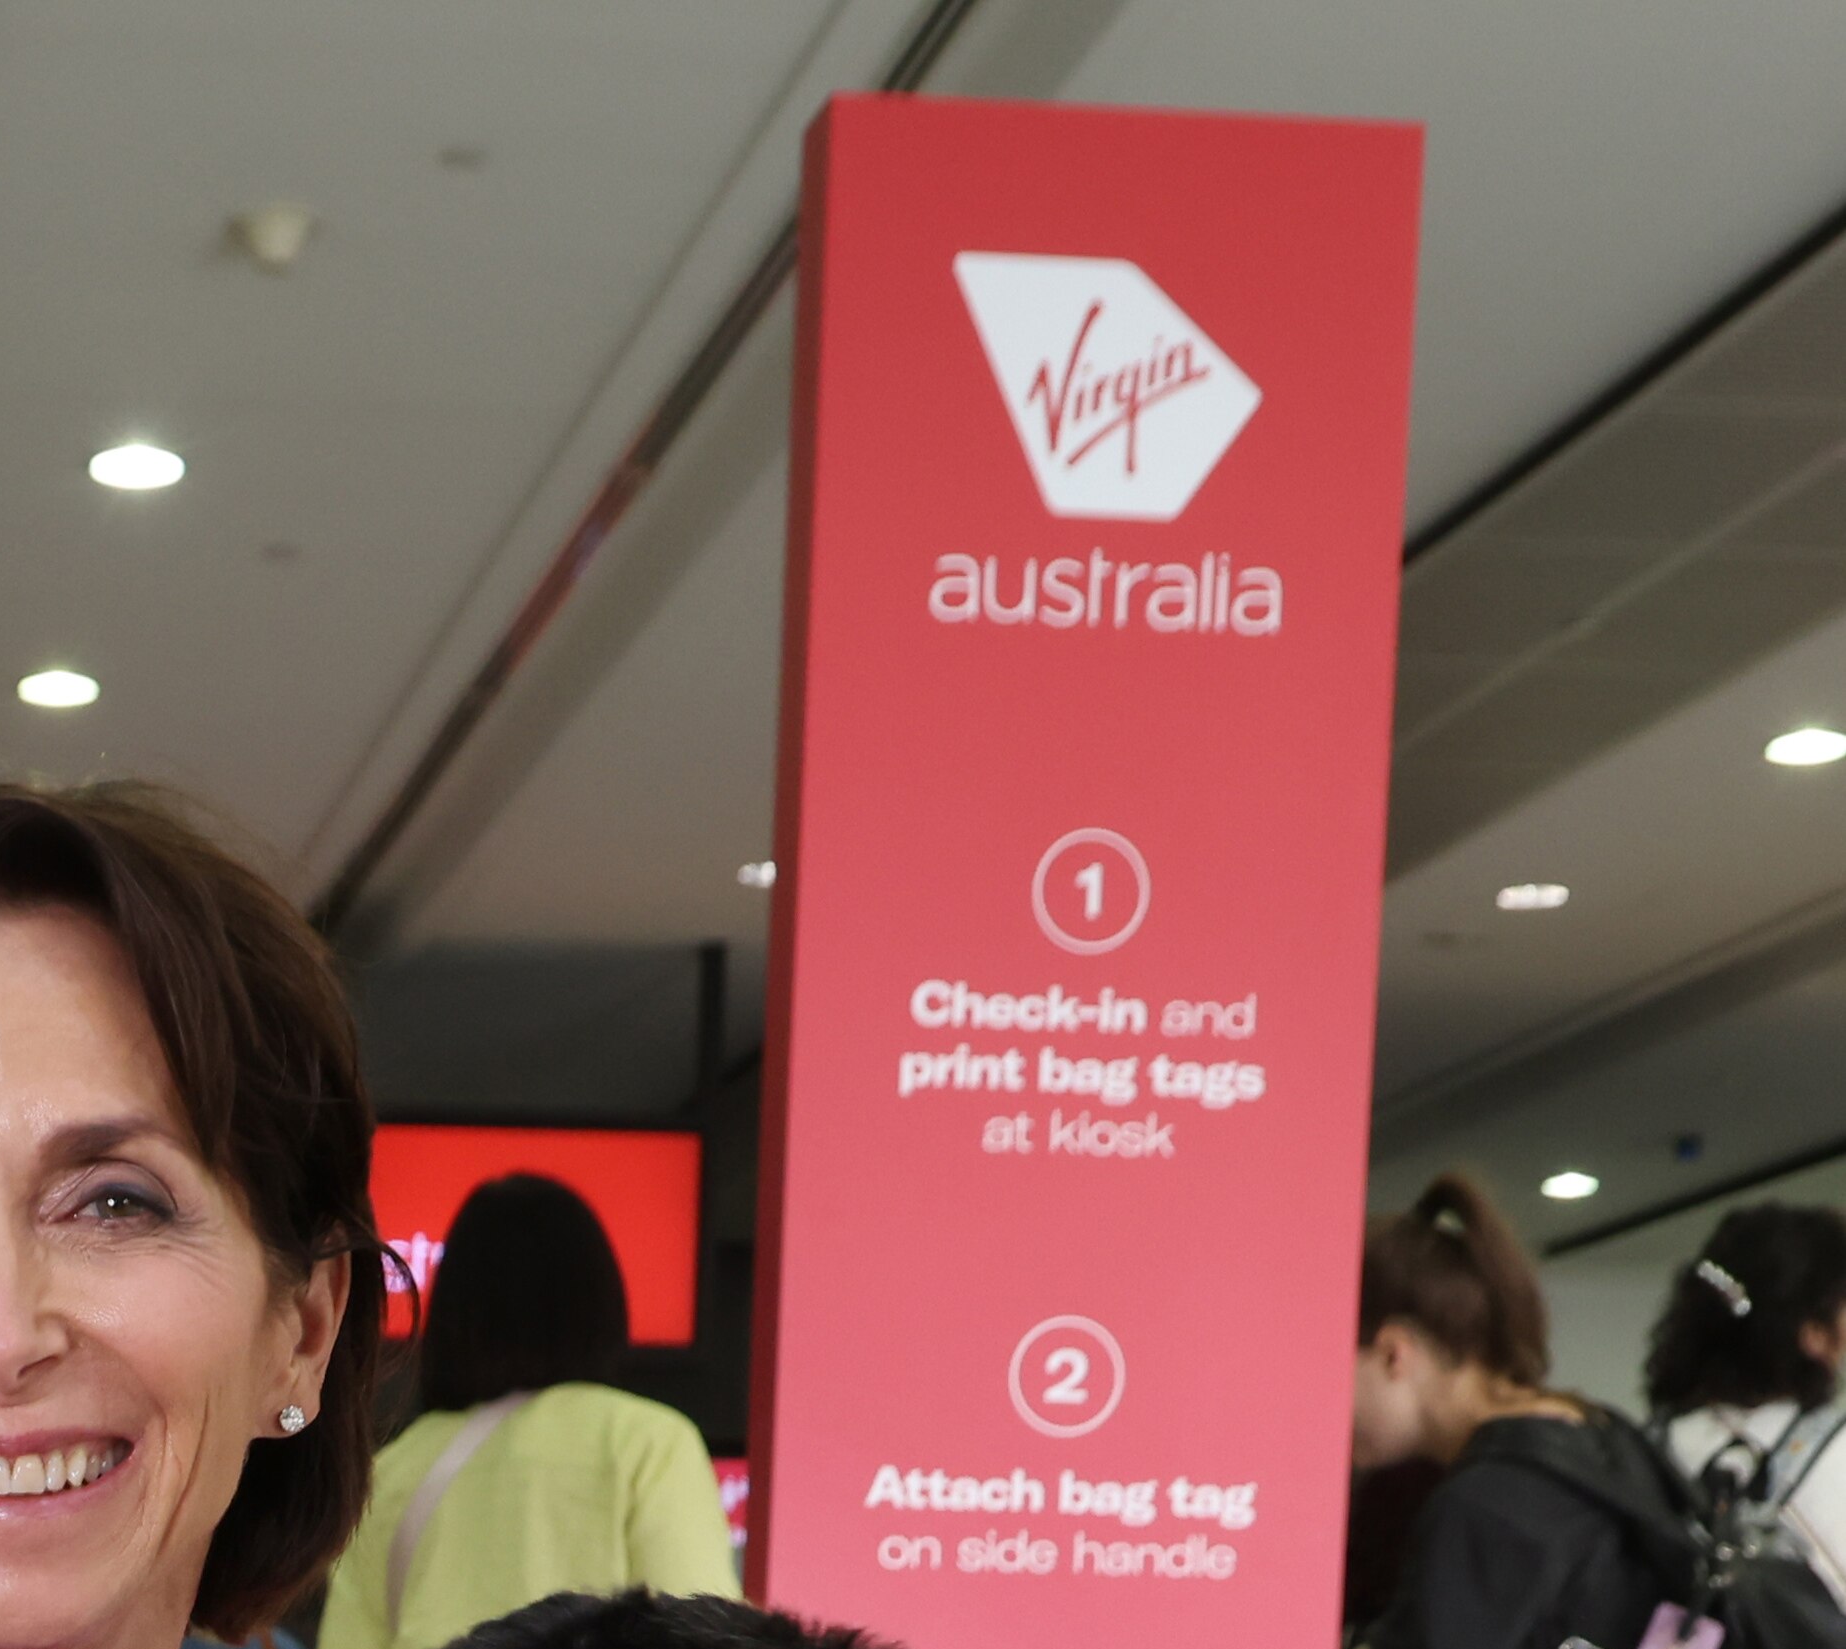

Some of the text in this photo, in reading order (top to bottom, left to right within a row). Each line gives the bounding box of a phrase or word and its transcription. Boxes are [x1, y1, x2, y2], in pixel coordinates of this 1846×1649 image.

[1026, 299, 1211, 477] Virgin
[927, 547, 1283, 637] australia
[1074, 862, 1104, 921] 1
[910, 980, 1257, 1039] Check-in and
[898, 1043, 1265, 1109] print bag tags
[982, 1108, 1175, 1158] at kiosk
[1042, 1347, 1089, 1404] 2
[864, 1464, 1258, 1529] Attach bag tag
[877, 1528, 1237, 1580] on side handle
